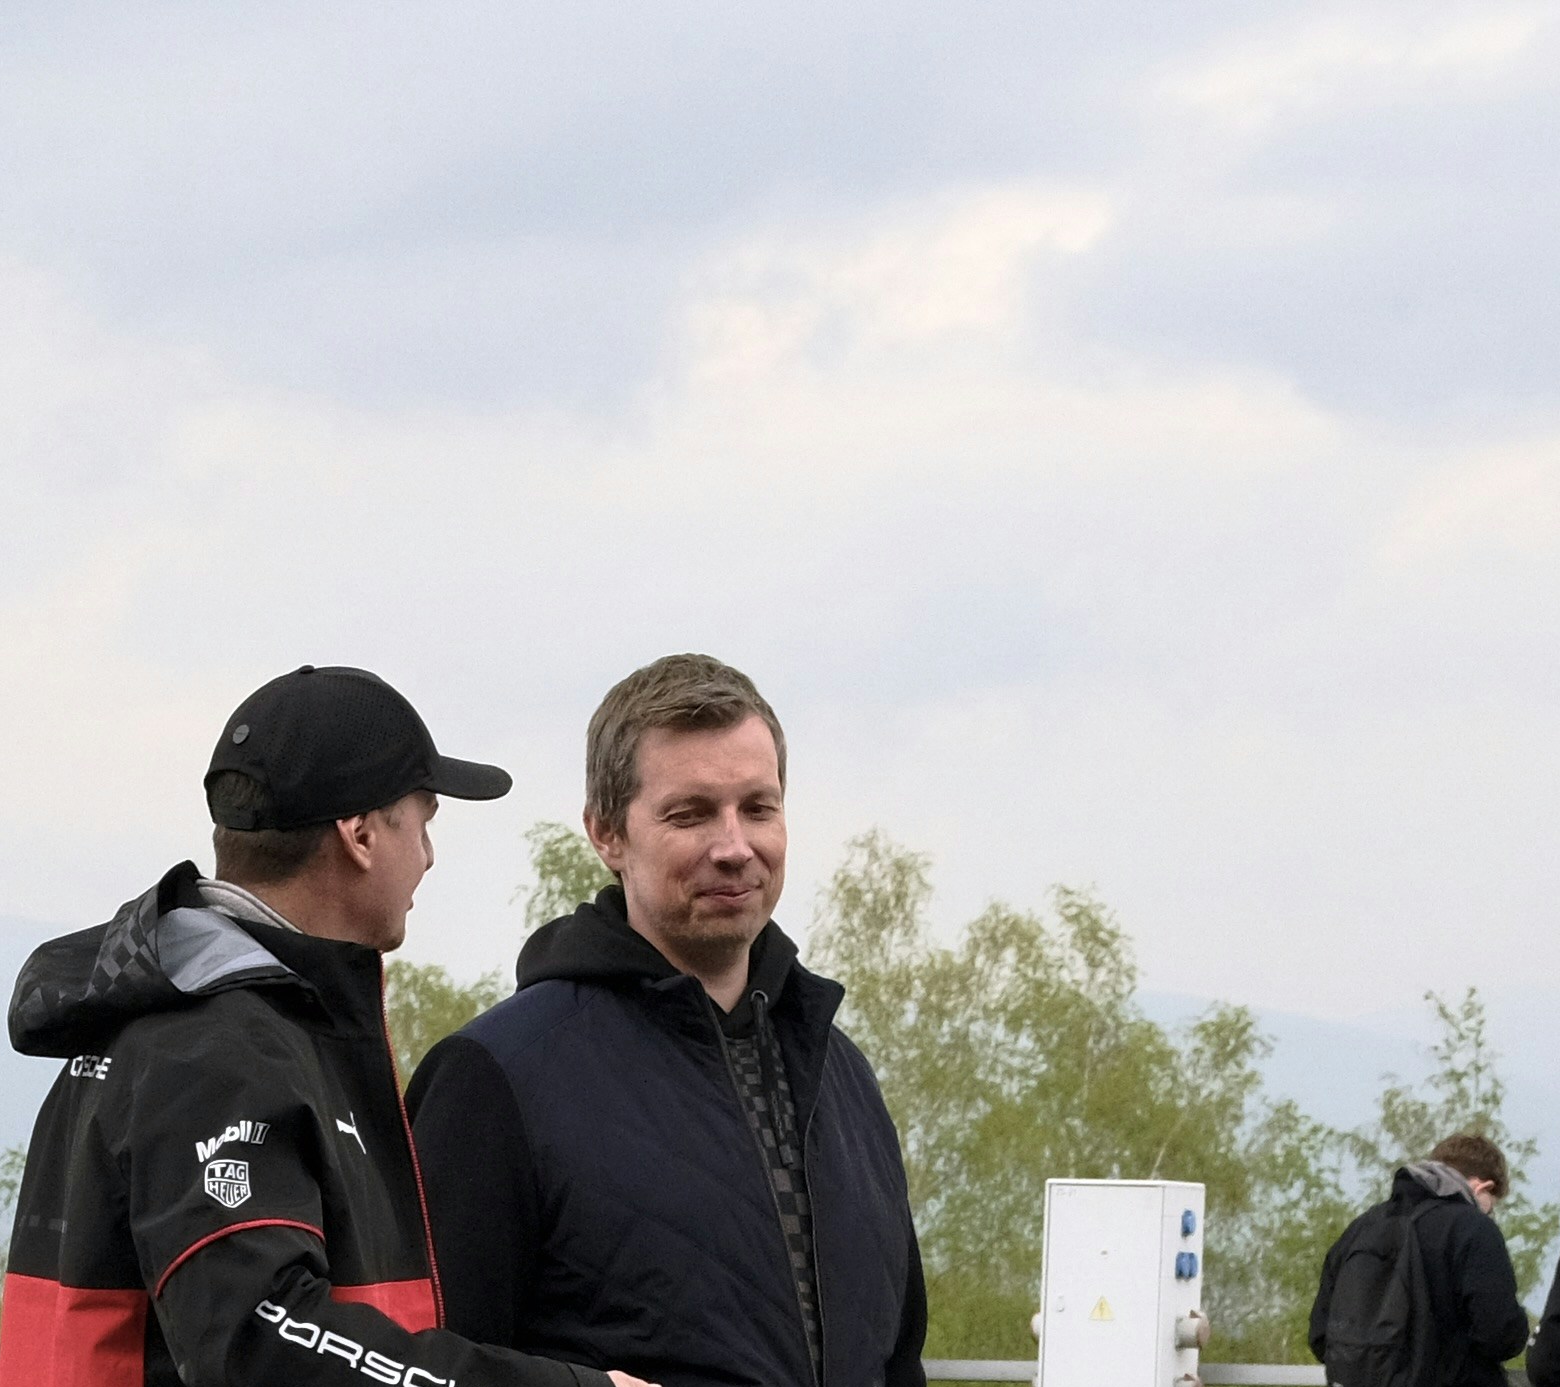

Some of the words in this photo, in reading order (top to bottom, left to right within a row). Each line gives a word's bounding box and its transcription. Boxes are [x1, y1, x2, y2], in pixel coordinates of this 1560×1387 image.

[195, 1121, 253, 1164] Mobil
[208, 1163, 246, 1180] TAG
[208, 1181, 247, 1205] HEUER
